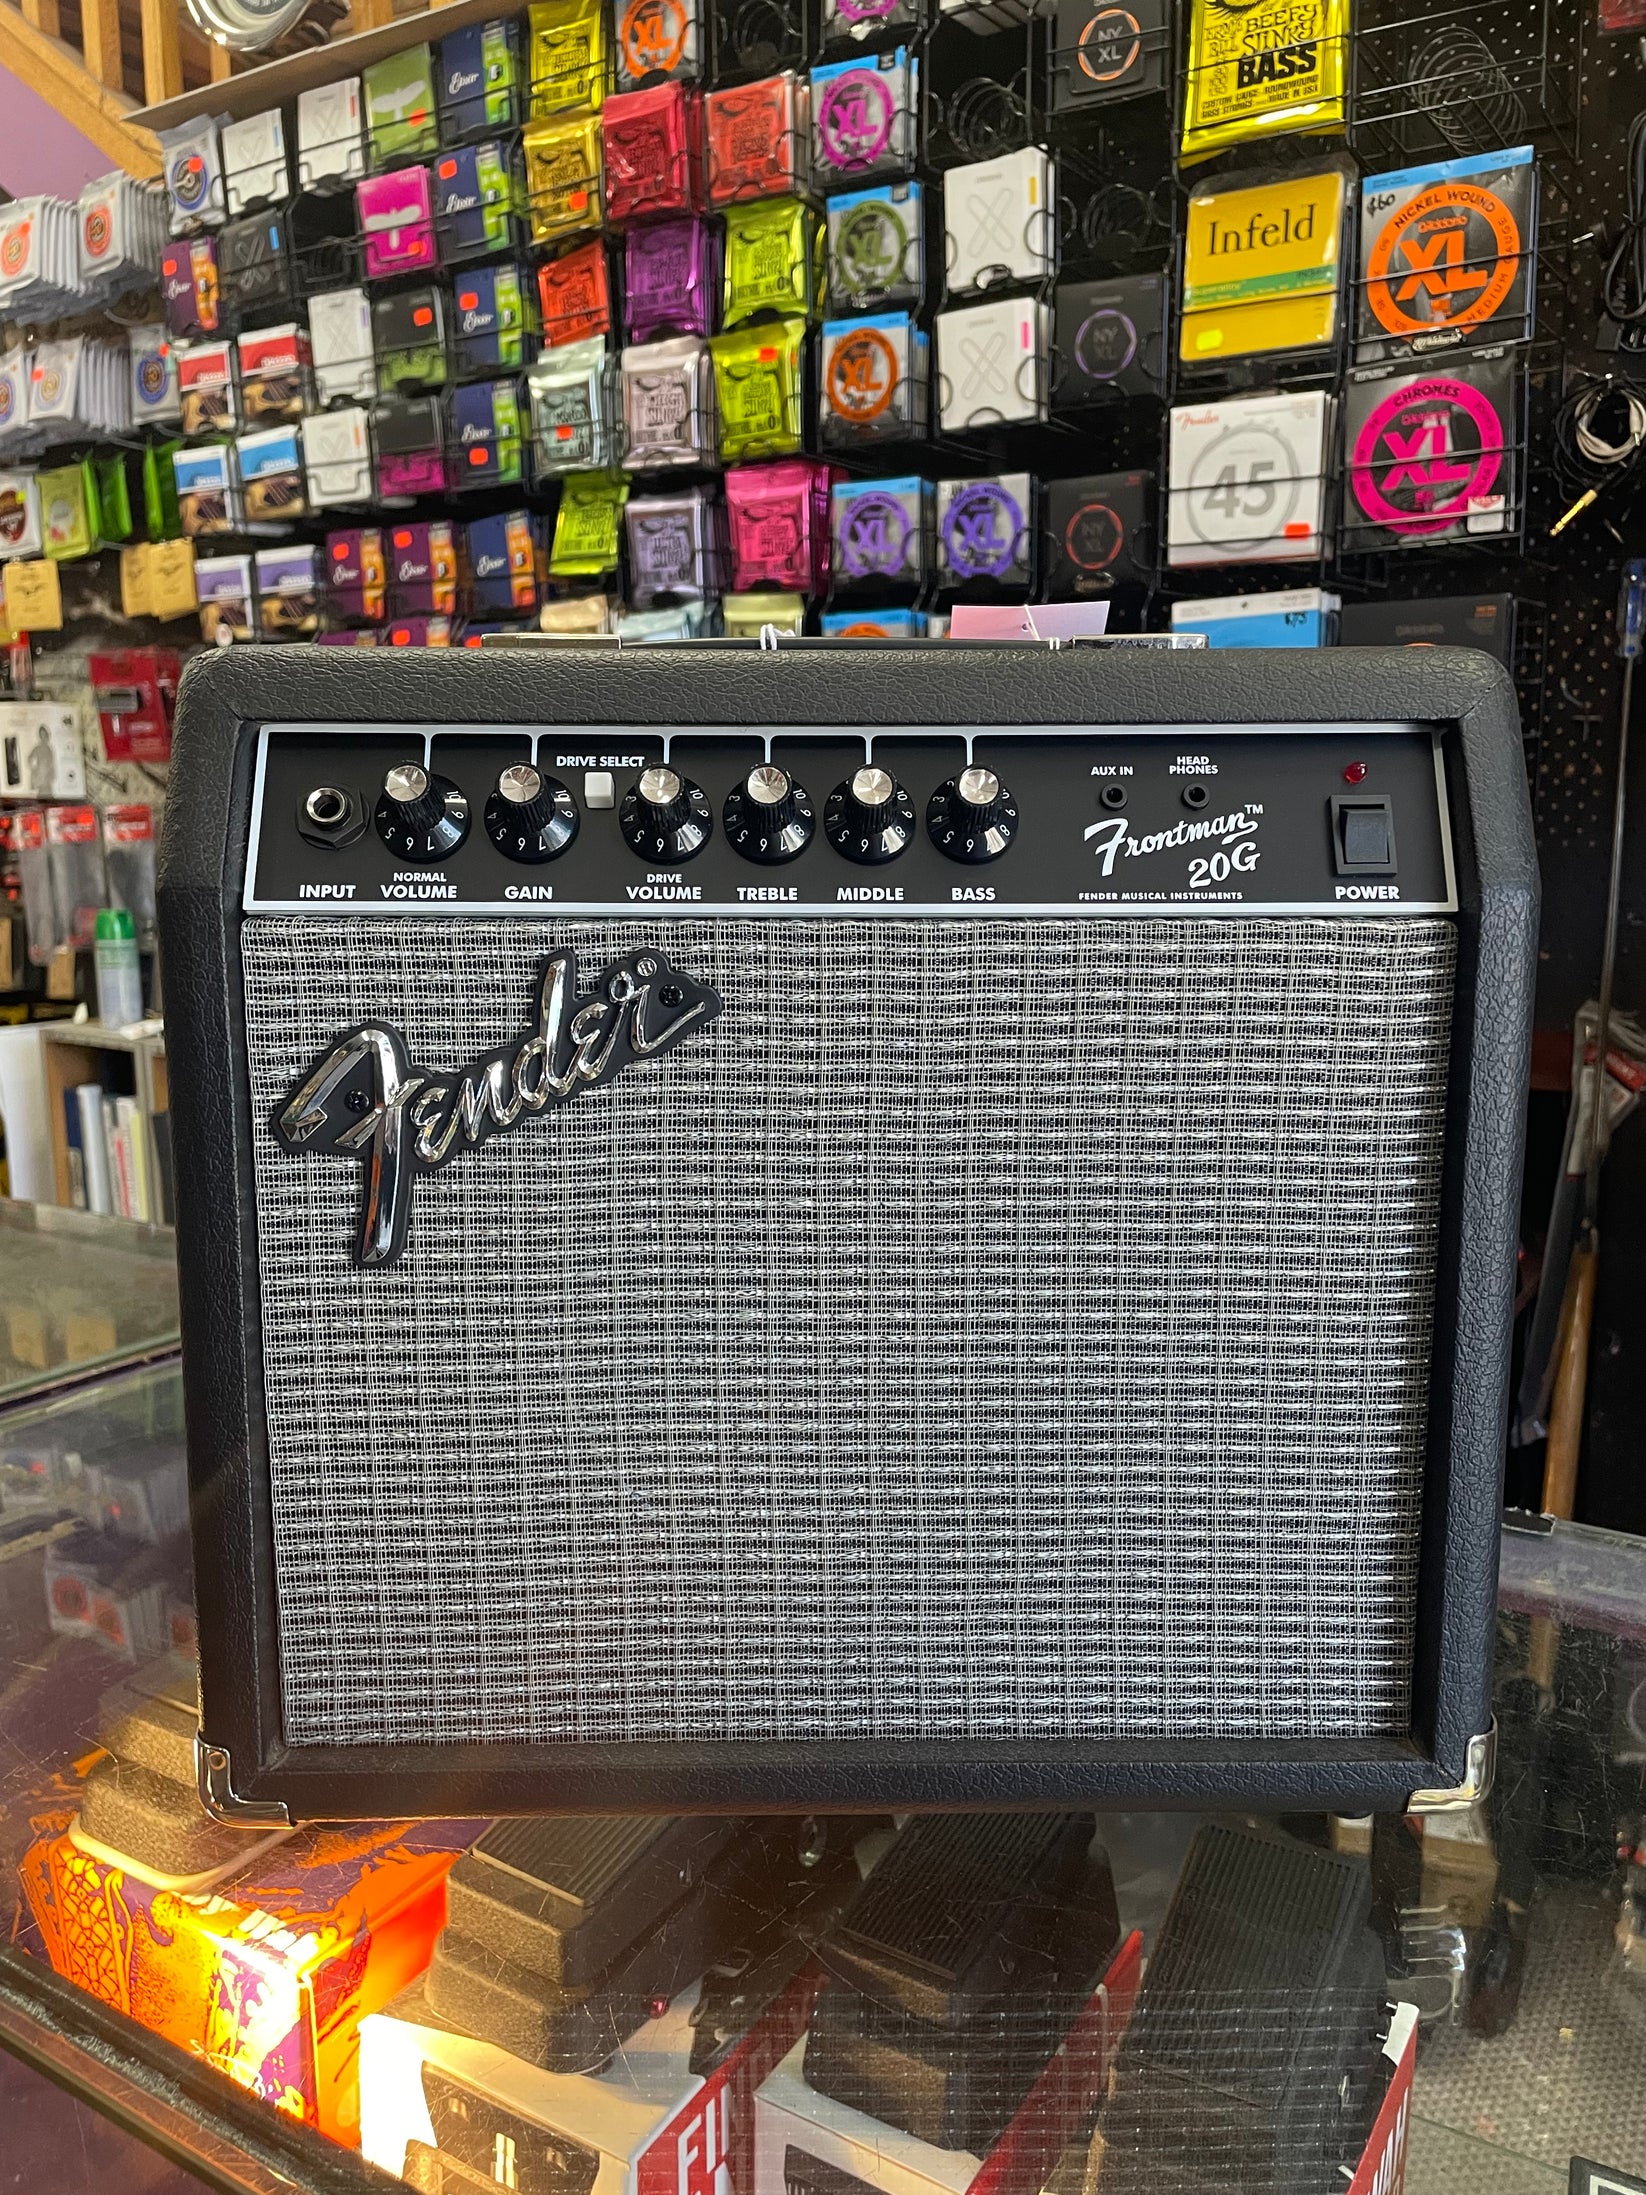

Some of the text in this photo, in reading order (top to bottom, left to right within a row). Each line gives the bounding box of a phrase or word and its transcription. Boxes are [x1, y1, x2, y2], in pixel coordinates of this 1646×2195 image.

[1246, 4, 1318, 33] BEEFY
[633, 14, 673, 55] XL
[1098, 26, 1123, 42] NY
[1098, 45, 1122, 63] XL
[1238, 42, 1317, 89] BASS
[832, 99, 878, 142] XL
[1394, 190, 1497, 230] NICKEL WOUND
[1207, 202, 1318, 257] Infeld
[850, 231, 894, 270] XL
[1394, 230, 1489, 302] XL
[841, 357, 883, 393] XL
[1393, 384, 1461, 408] CHROMES
[1380, 425, 1472, 492] XL
[1203, 461, 1277, 519] 45
[853, 519, 897, 552] XL
[958, 511, 1006, 551] XL
[556, 755, 645, 768] DRIVE SELECT
[1176, 755, 1210, 766] HEAD
[1090, 765, 1134, 777] AUX IN
[1168, 764, 1219, 776] PHONES
[689, 788, 704, 800] 10
[792, 788, 807, 800] 10
[896, 790, 908, 801] 10
[696, 809, 709, 817] 9
[799, 808, 812, 817] 9
[901, 810, 913, 819] 9
[1004, 808, 1016, 817] 9
[384, 826, 396, 840] 5
[405, 836, 414, 851] 6
[426, 835, 435, 852] 7
[450, 810, 465, 819] 9
[495, 827, 507, 841] 5
[517, 837, 526, 851] 6
[538, 835, 547, 851] 7
[560, 809, 574, 819] 9
[633, 829, 645, 843] 5
[736, 829, 749, 843] 5
[793, 824, 805, 837] 8
[837, 829, 850, 843] 5
[895, 825, 906, 839] 8
[942, 830, 955, 844] 5
[999, 824, 1011, 837] 8
[656, 838, 665, 853] 6
[759, 838, 768, 852] 6
[860, 838, 869, 853] 6
[966, 838, 975, 853] 6
[1083, 810, 1259, 877] Frontman
[1188, 841, 1261, 889] 20G
[393, 872, 447, 883] NORMAL
[645, 873, 682, 884] DRIVE
[299, 884, 357, 899] INPUT
[380, 884, 458, 899] VOLUME
[504, 885, 554, 900] GAIN
[625, 886, 702, 901] VOLUME
[736, 886, 799, 902] TREBLE
[836, 886, 905, 902] MIDDLE
[951, 886, 997, 902] BASS
[1078, 892, 1244, 901] FENDER MUSICAL INSTRUMENTS
[1334, 885, 1401, 901] POWER
[280, 957, 706, 1264] Fender
